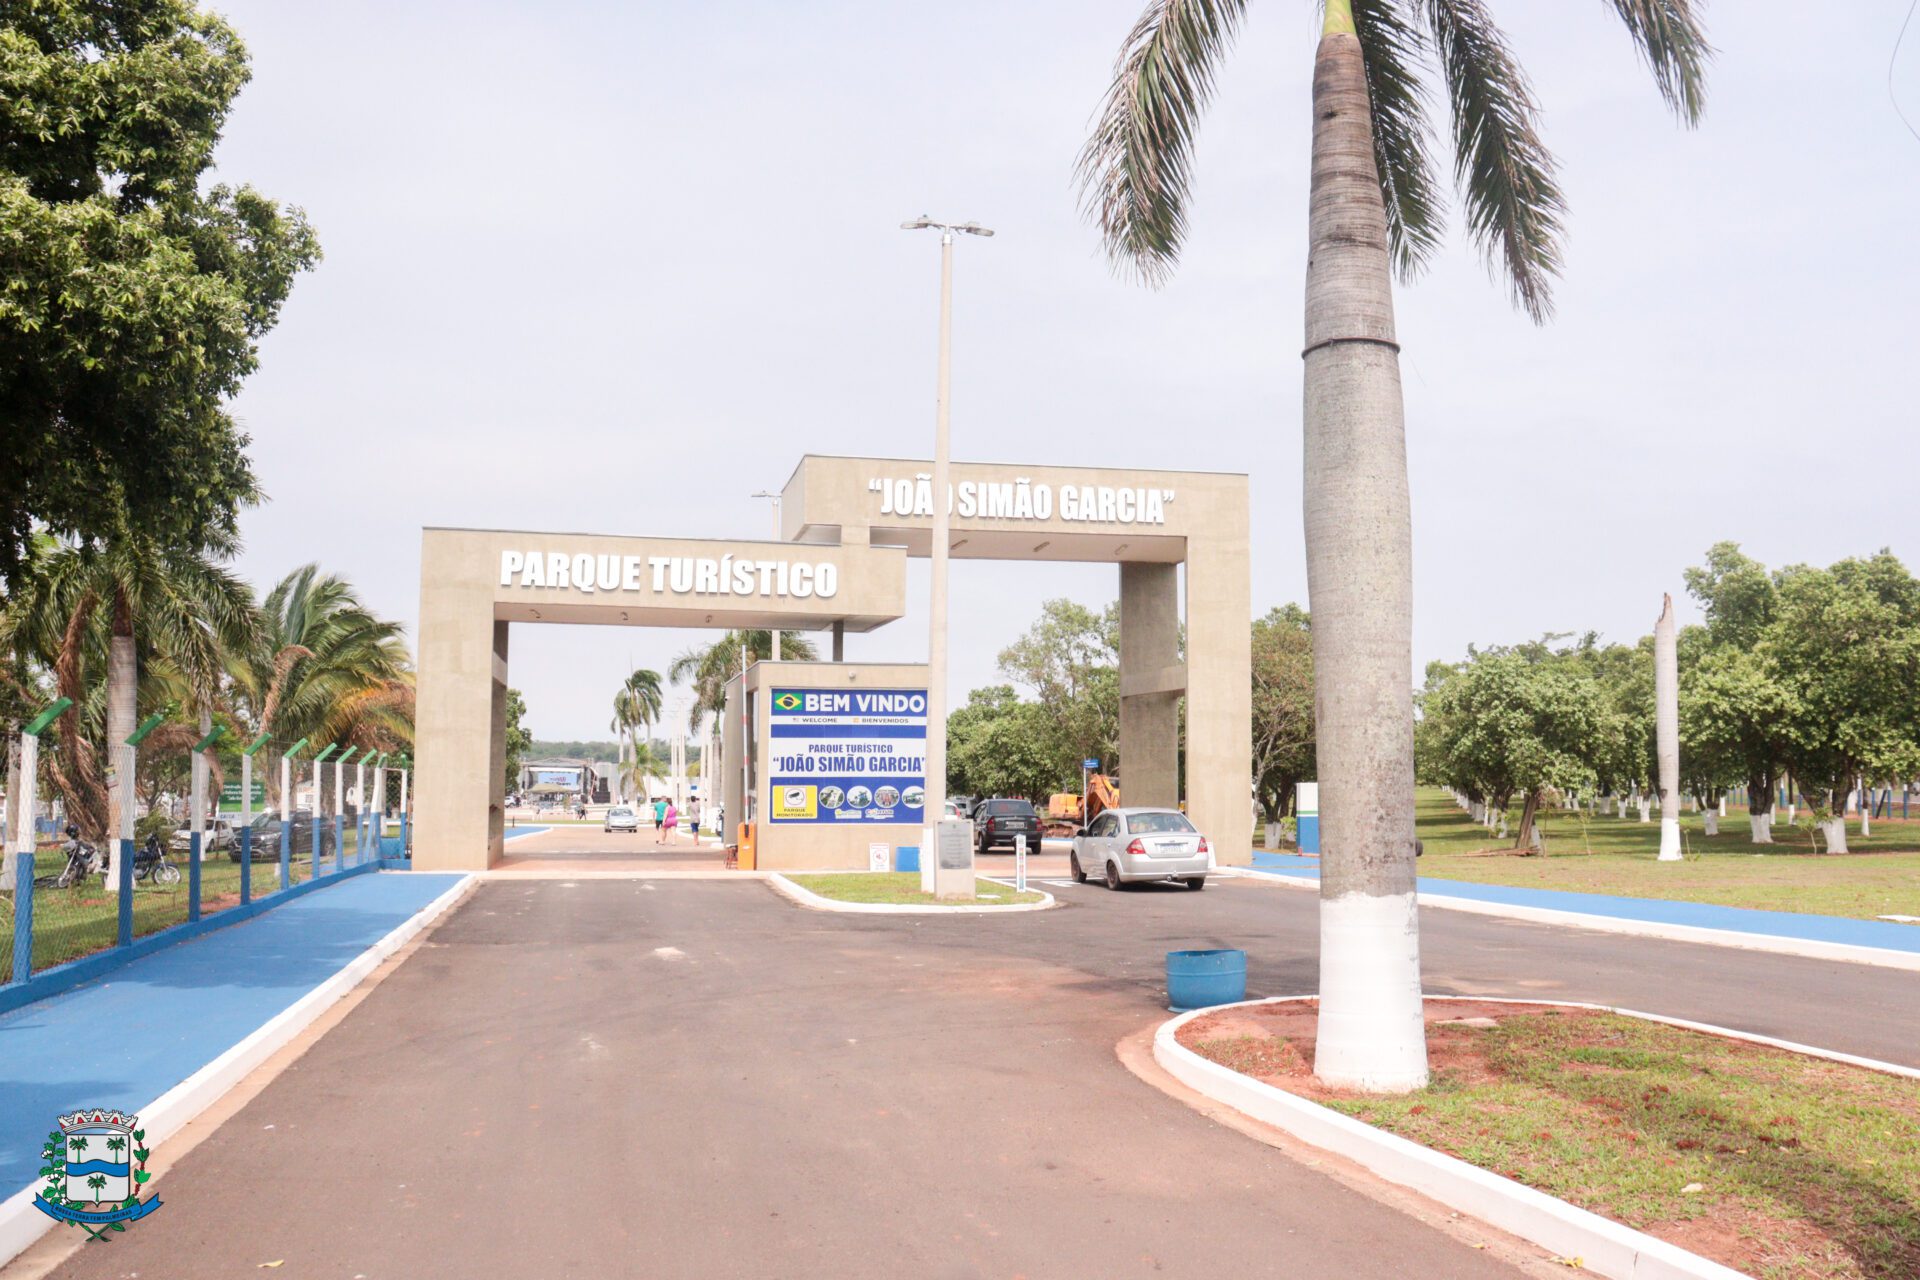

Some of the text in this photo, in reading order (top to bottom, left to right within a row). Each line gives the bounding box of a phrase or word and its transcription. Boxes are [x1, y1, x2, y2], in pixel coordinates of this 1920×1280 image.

[868, 472, 1176, 524] “JOÃ SIMÃO GARCIA”
[500, 550, 838, 598] PARQUE TURÍSTICO
[805, 694, 925, 713] BEM VINDO
[808, 743, 893, 754] PARQUE TURÍSTICO
[773, 754, 815, 772] “JOÃO
[818, 754, 865, 772] SIMÃO
